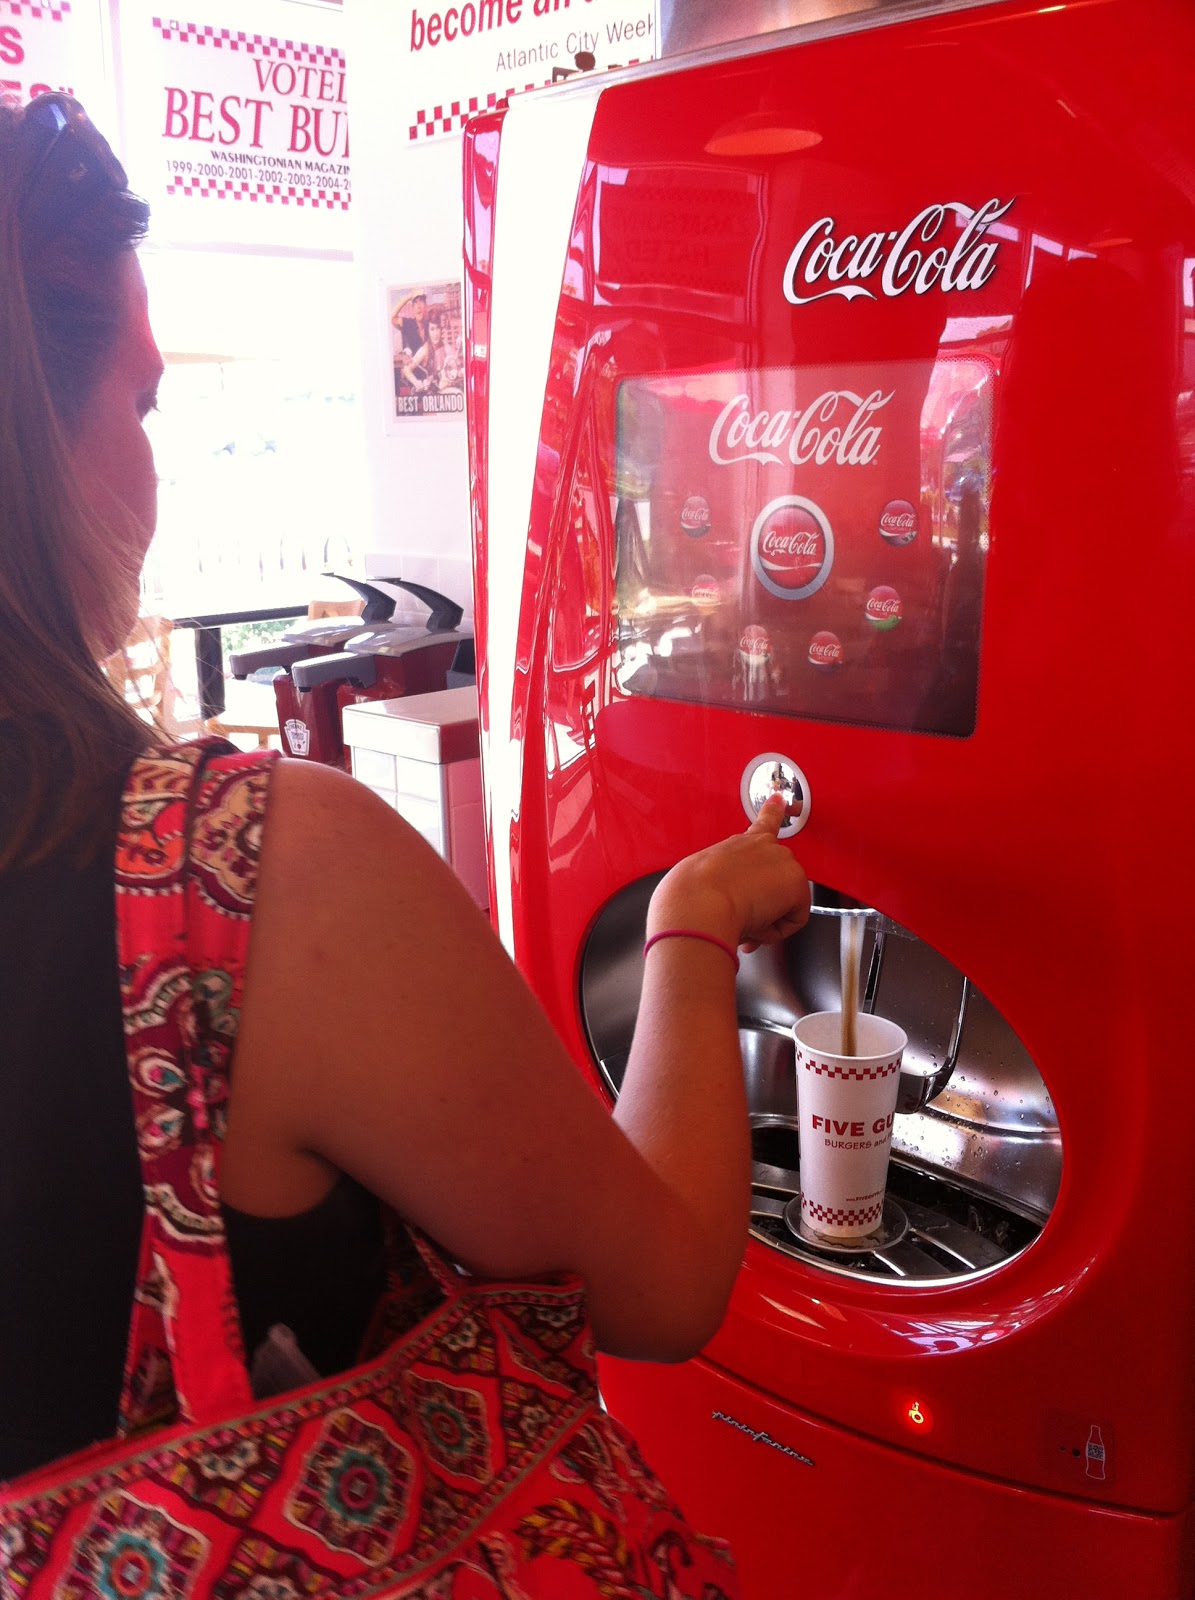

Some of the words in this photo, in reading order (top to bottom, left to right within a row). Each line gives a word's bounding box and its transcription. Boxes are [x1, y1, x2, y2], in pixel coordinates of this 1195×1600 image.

[410, 0, 522, 52] become
[496, 41, 559, 72] Atlantic
[566, 30, 600, 54] City
[162, 86, 274, 149] BEST
[210, 149, 302, 170] WASHINGTONIAN
[782, 195, 1017, 305] Coca-Cola
[398, 396, 419, 413] BEST
[422, 393, 464, 413] ORLANDO
[708, 389, 896, 466] Coca-Cola
[762, 530, 820, 557] Coca-Cola
[812, 1114, 865, 1137] FIVE
[824, 1139, 872, 1150] BURGERS
